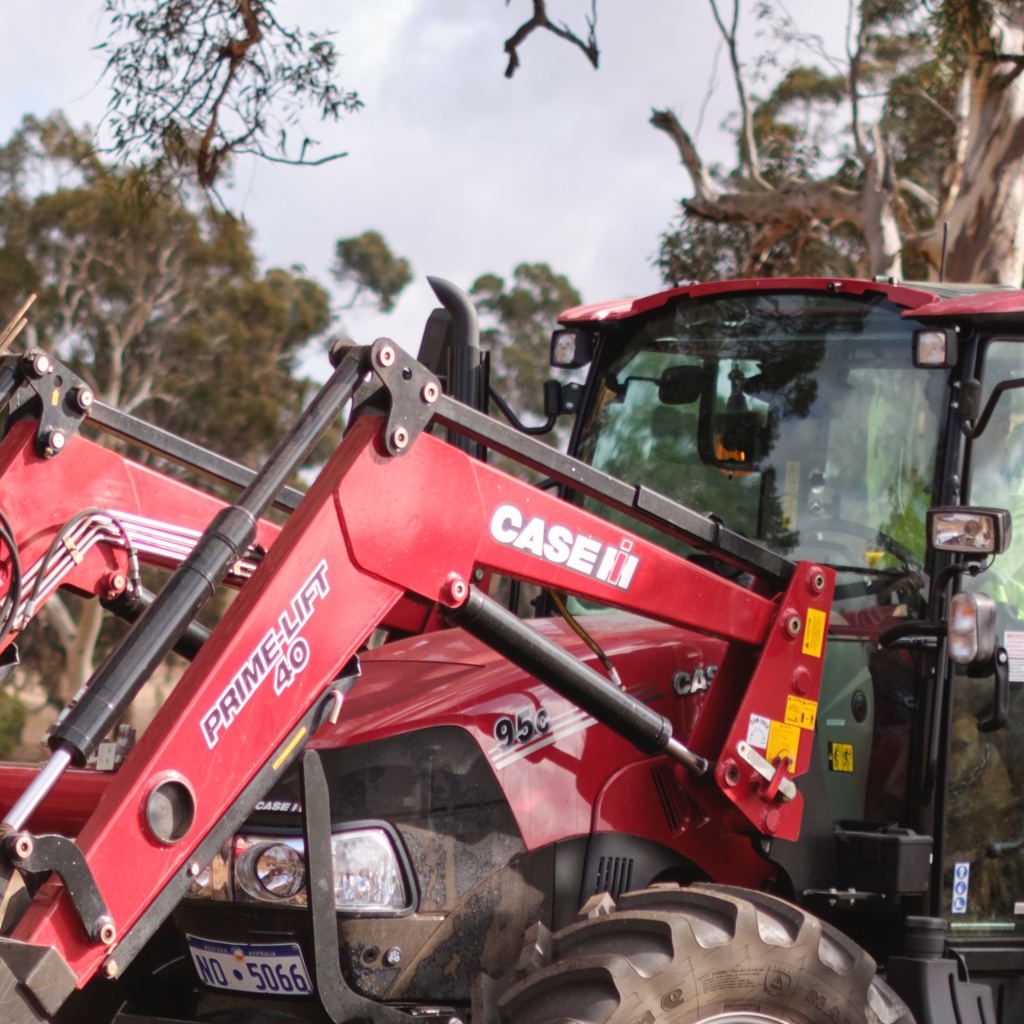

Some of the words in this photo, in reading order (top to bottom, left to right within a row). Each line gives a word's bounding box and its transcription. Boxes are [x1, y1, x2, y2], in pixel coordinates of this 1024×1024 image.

[489, 503, 603, 577] CASE
[199, 558, 330, 750] PRIME-LIFT
[273, 636, 310, 697] 40
[672, 663, 719, 696] CAS
[255, 801, 291, 812] CASE
[203, 945, 228, 954] WESTERN
[248, 949, 277, 957] AUSTRALIA
[195, 953, 229, 987] NO
[245, 962, 309, 992] 5066
